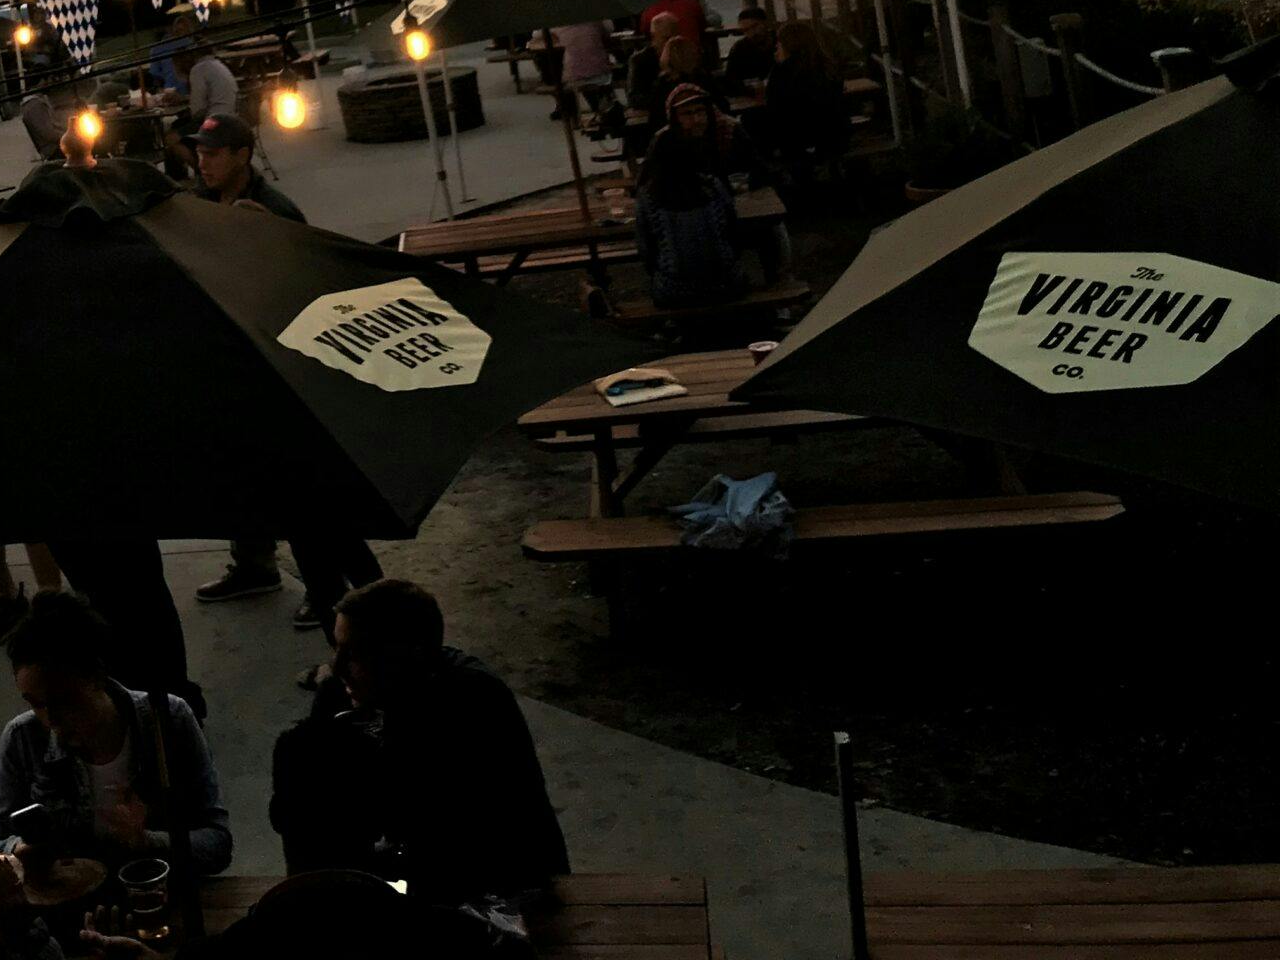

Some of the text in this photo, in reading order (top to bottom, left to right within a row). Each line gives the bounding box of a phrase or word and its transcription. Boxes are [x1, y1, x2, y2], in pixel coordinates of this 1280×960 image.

[1131, 267, 1165, 281] The
[1018, 273, 1232, 343] VIRGINIA
[314, 298, 448, 365] VIRGINIA
[383, 332, 454, 369] BEER
[1037, 322, 1148, 363] BEER
